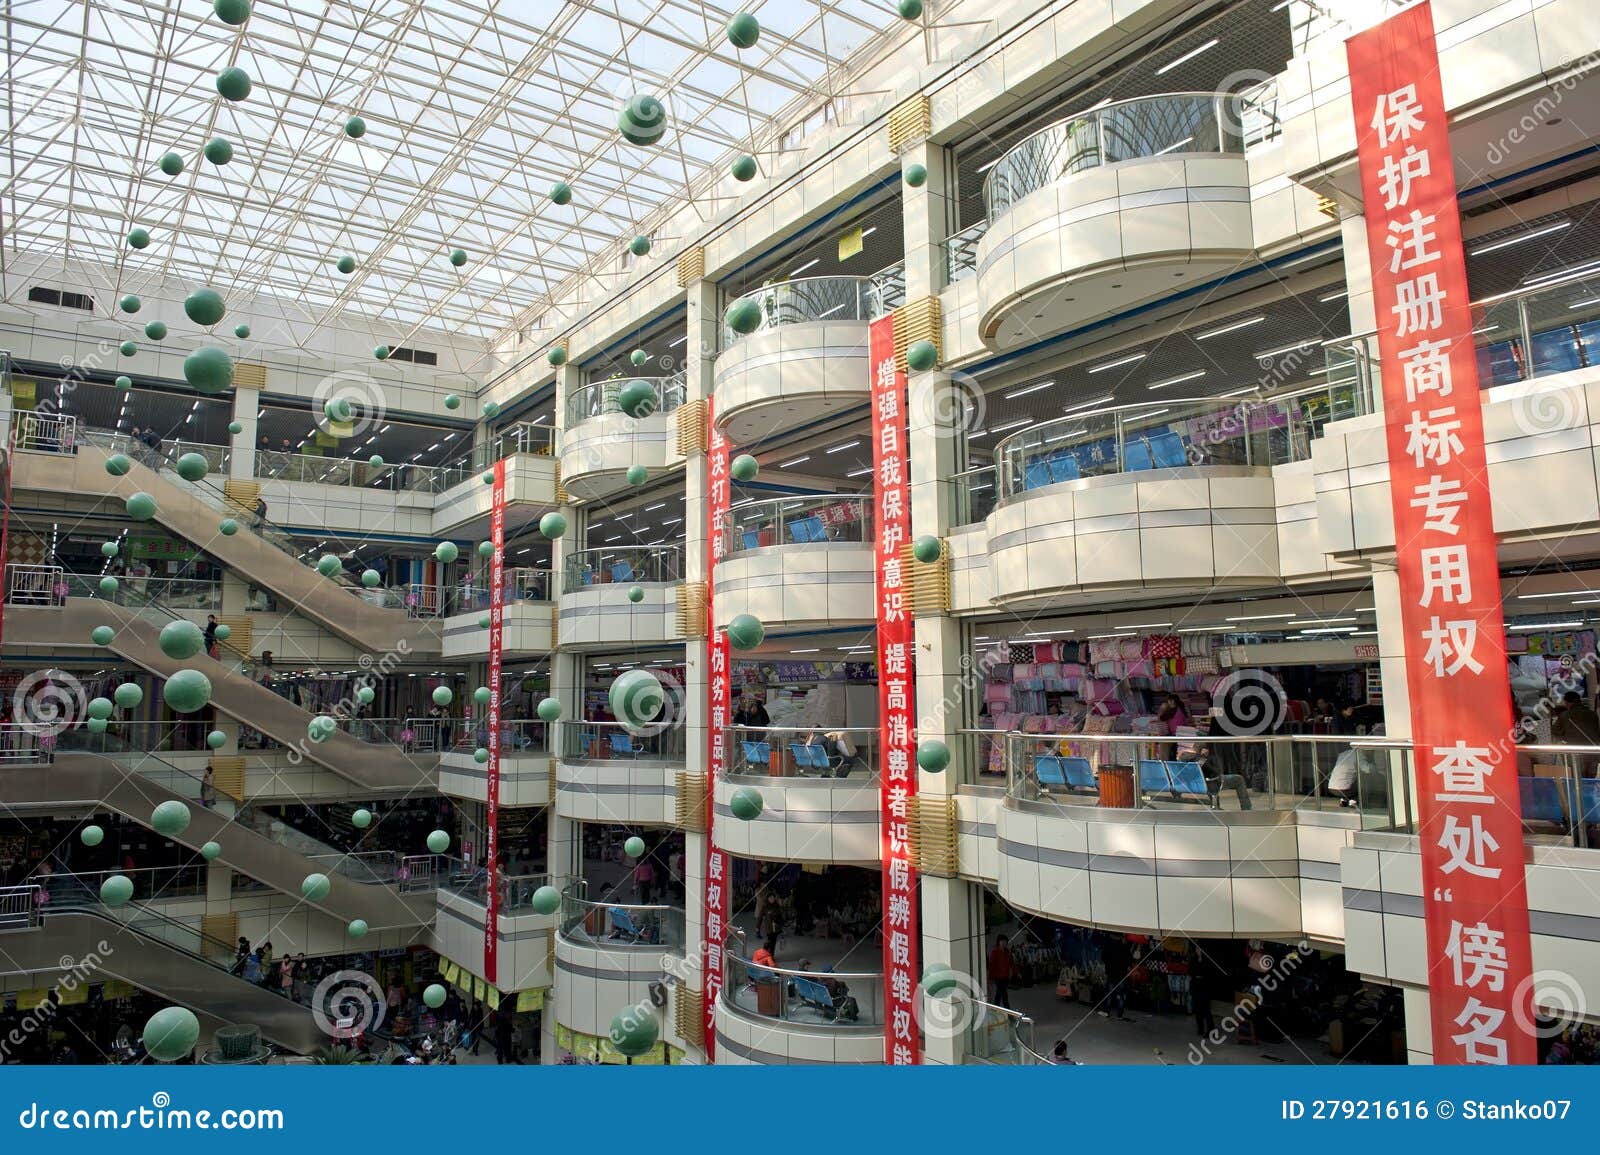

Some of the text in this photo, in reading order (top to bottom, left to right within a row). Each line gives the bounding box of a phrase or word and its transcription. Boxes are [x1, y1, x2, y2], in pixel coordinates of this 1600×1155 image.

[876, 356, 905, 623] 增强自我保护意识
[1370, 83, 1484, 677] 保护注册商标专用权
